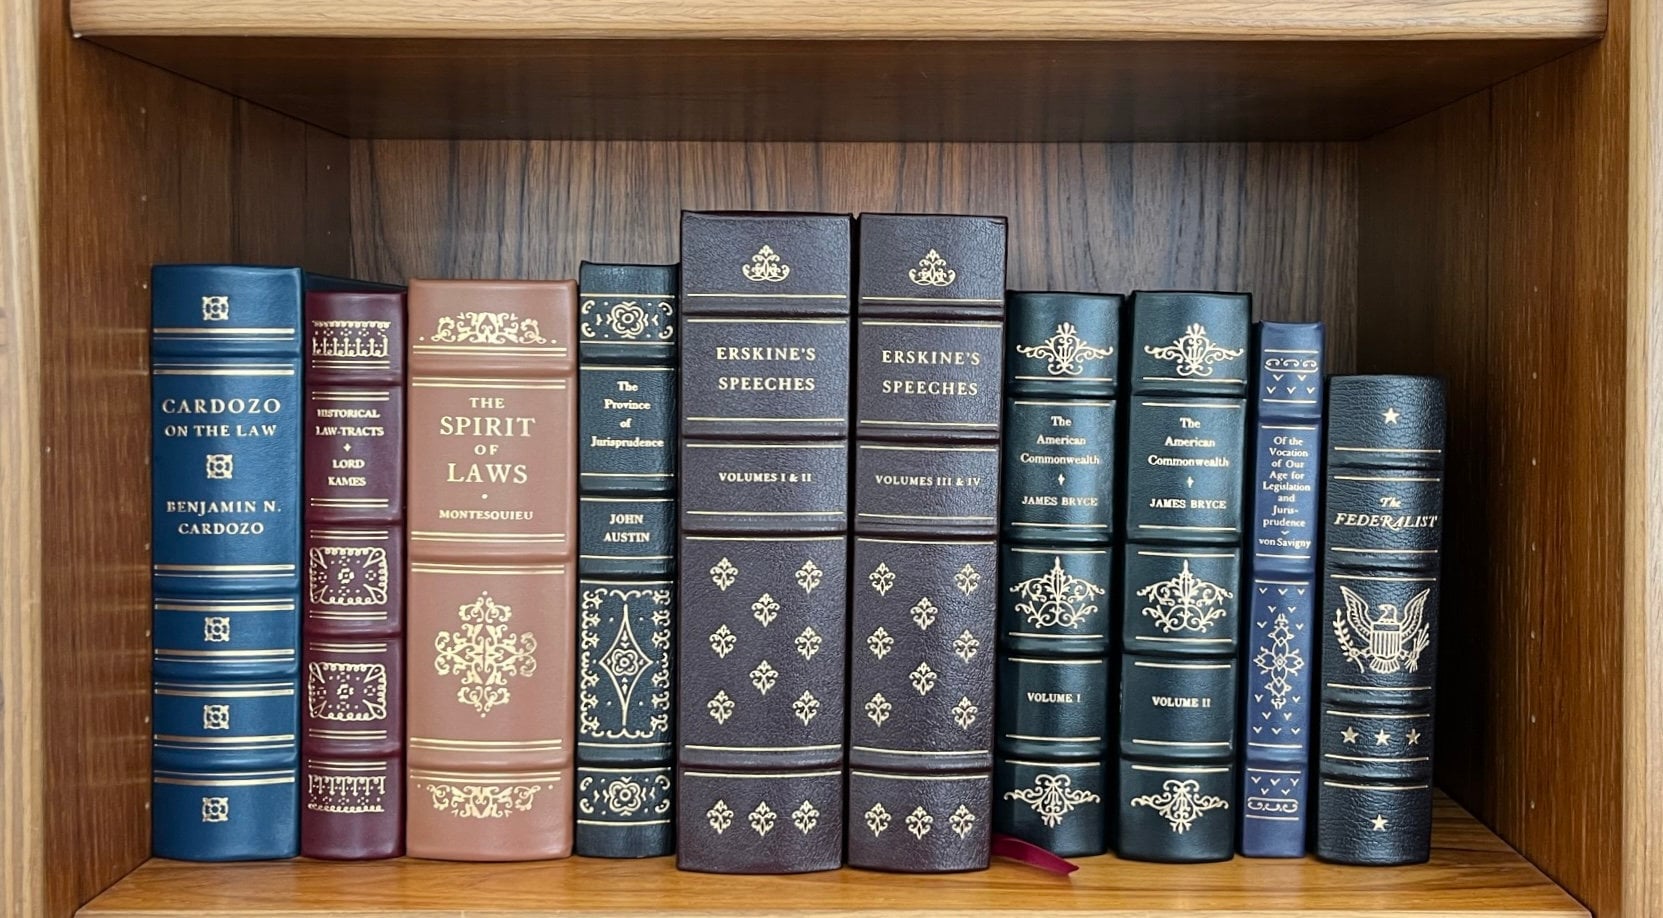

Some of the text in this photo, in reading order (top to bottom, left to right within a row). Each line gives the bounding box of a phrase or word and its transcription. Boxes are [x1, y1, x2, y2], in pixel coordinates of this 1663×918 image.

[716, 347, 816, 361] ERSKINE'S
[882, 350, 980, 365] ERSKINE'S
[617, 381, 638, 392] The
[718, 377, 816, 391] SPEECHES
[882, 380, 978, 396] SPEECHES
[162, 398, 281, 414] CARDOZO
[469, 398, 505, 409] THE
[604, 399, 651, 410] Province
[317, 409, 381, 418] HISTORICAL
[439, 416, 536, 437] SPIRIT
[619, 418, 632, 428] of
[1051, 416, 1072, 427] The
[1180, 417, 1201, 428] The
[165, 425, 277, 437] ON THE LAW
[315, 426, 384, 436] LAW-TRACTS
[590, 437, 664, 448] Jurisprudence
[1037, 435, 1086, 445] American
[1164, 436, 1216, 447] American
[1273, 436, 1303, 446] Of the
[474, 445, 499, 455] OF
[1269, 448, 1308, 457] Vocation
[332, 459, 365, 468] LORD
[1020, 453, 1100, 465] Commonwealth
[1148, 455, 1229, 467] Commonwealth
[1271, 459, 1304, 468] of Our
[447, 463, 528, 484] LAWS
[718, 472, 812, 482] VOLUMES I & II
[1269, 471, 1304, 480] Age for
[328, 477, 366, 486] KAMES
[875, 475, 981, 486] VOLUMES III & IV
[1262, 482, 1311, 492] Legislation
[1021, 496, 1098, 506] JAMES BRYCE
[1278, 494, 1295, 502] and
[1379, 497, 1401, 507] The
[166, 501, 281, 516] BENJAMIN N.
[1150, 499, 1227, 509] JAMES BRYCE
[439, 510, 534, 520] MONTESQUIEU
[609, 514, 644, 524] JOHN
[1263, 518, 1306, 528] prudence
[1334, 513, 1437, 530] FEDERALIST
[178, 523, 264, 535] CARDOZO
[603, 532, 650, 542] AUSTIN
[1276, 538, 1311, 548] Savigny
[1027, 692, 1081, 703] VOLUME I
[1152, 696, 1211, 708] VOLUME II
